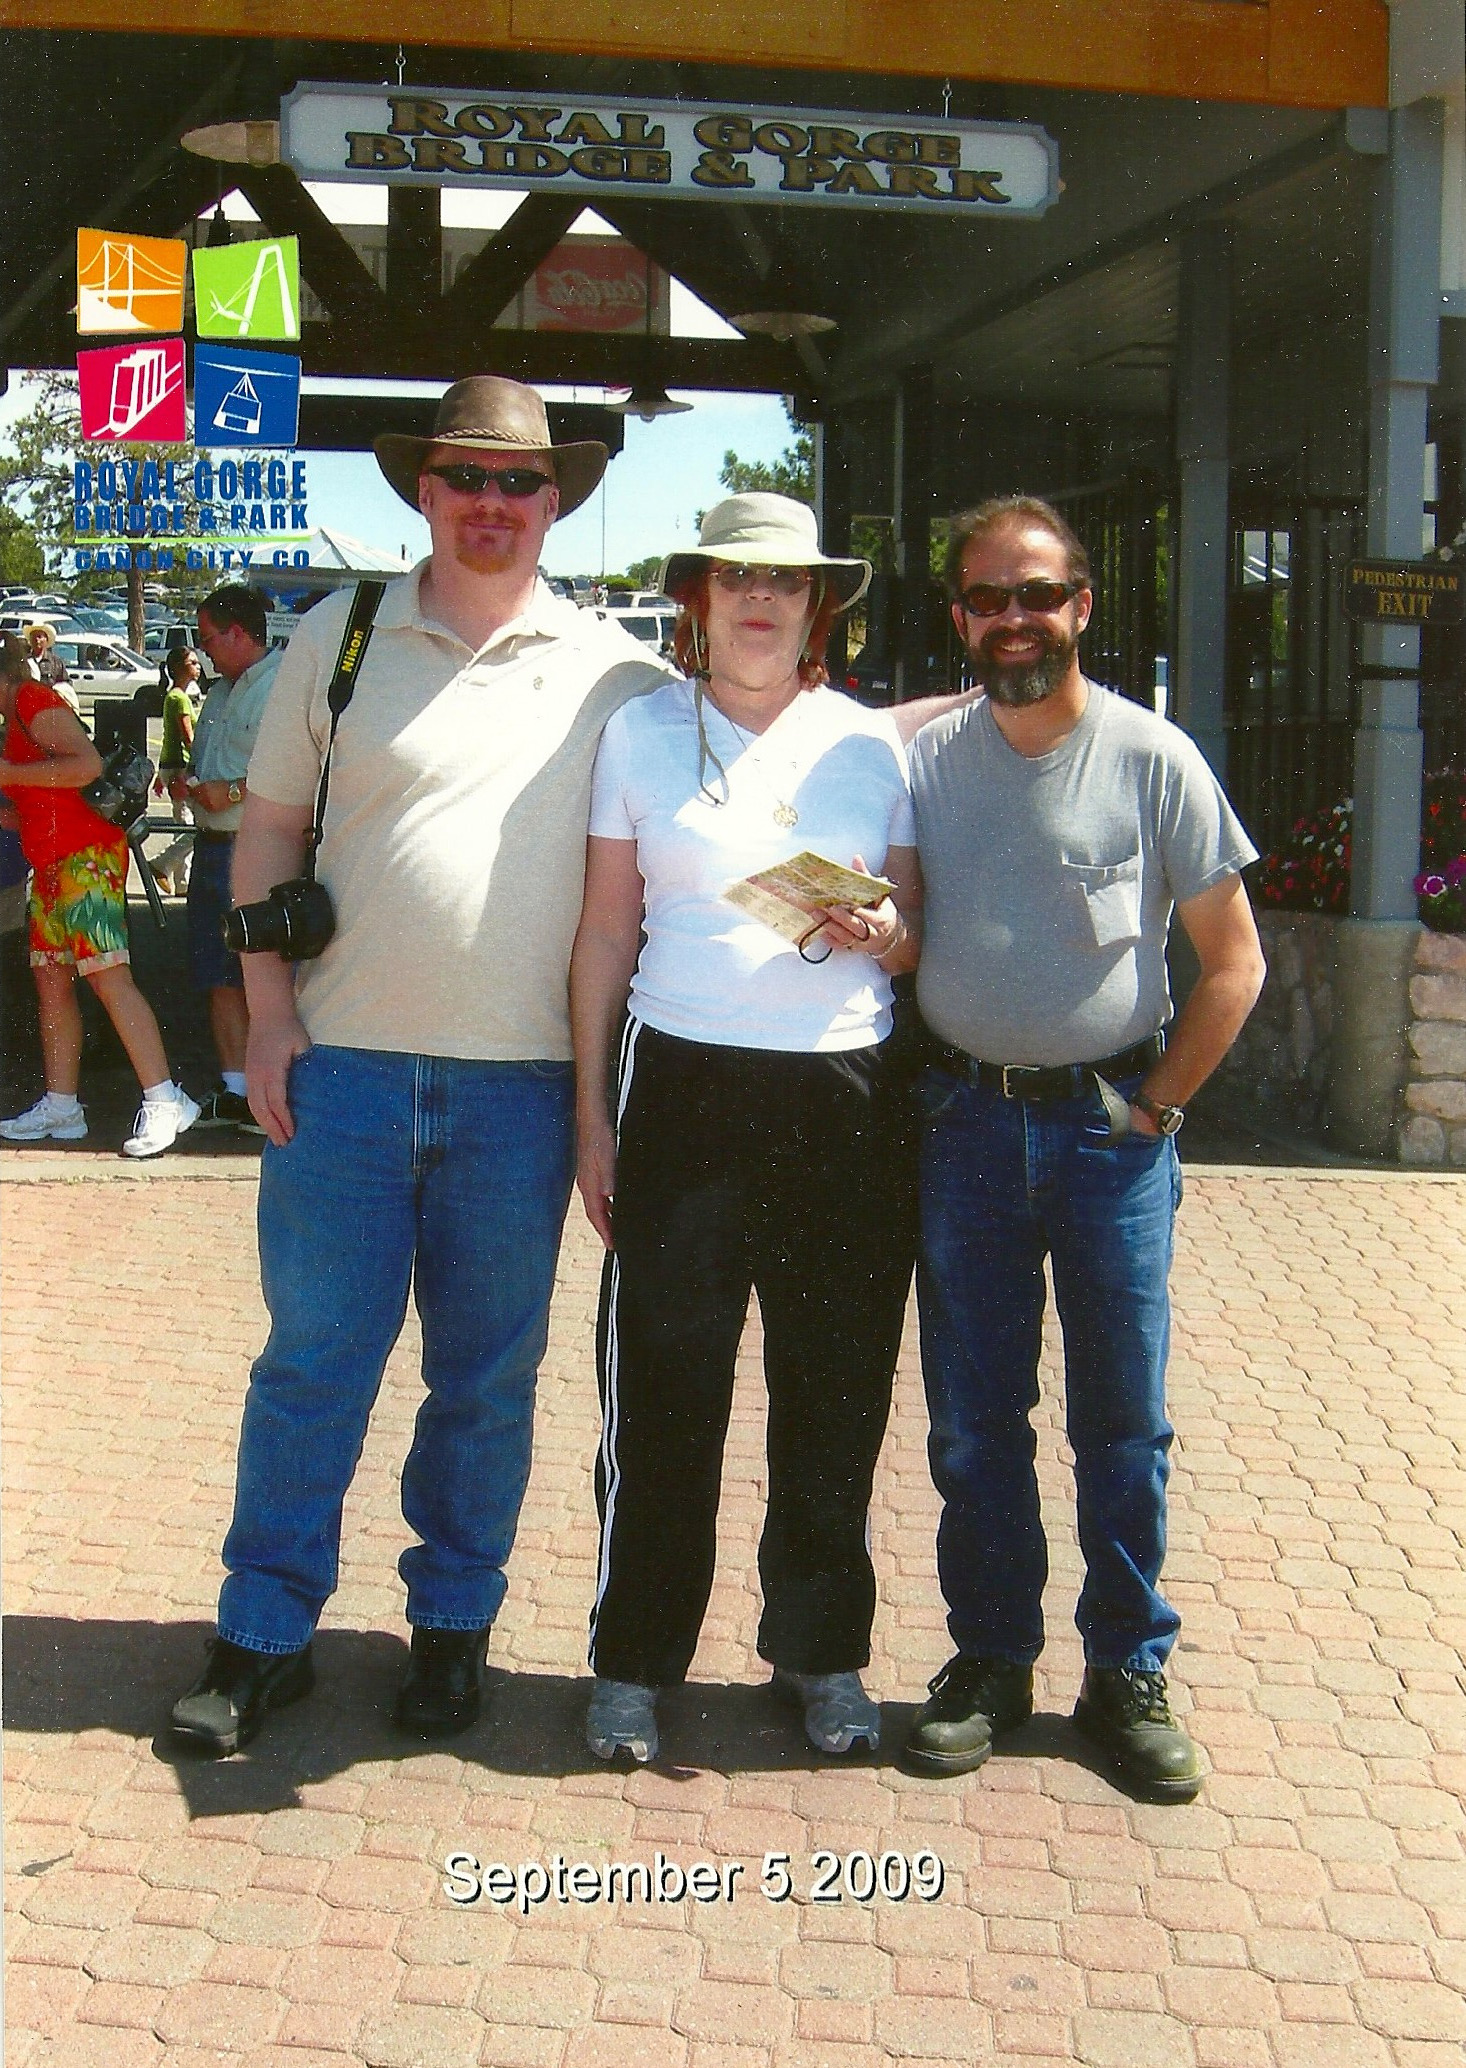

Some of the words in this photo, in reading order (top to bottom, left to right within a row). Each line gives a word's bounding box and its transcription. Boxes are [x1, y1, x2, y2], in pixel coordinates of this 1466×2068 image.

[388, 98, 665, 148] ROYAL
[693, 114, 961, 168] GORGE
[345, 131, 671, 184] BRIDGE
[690, 150, 755, 188] &
[779, 153, 1012, 203] PARK
[1353, 568, 1458, 591] PEDESTRIAN
[1379, 591, 1431, 615] EXIT
[341, 630, 364, 672] Nikon
